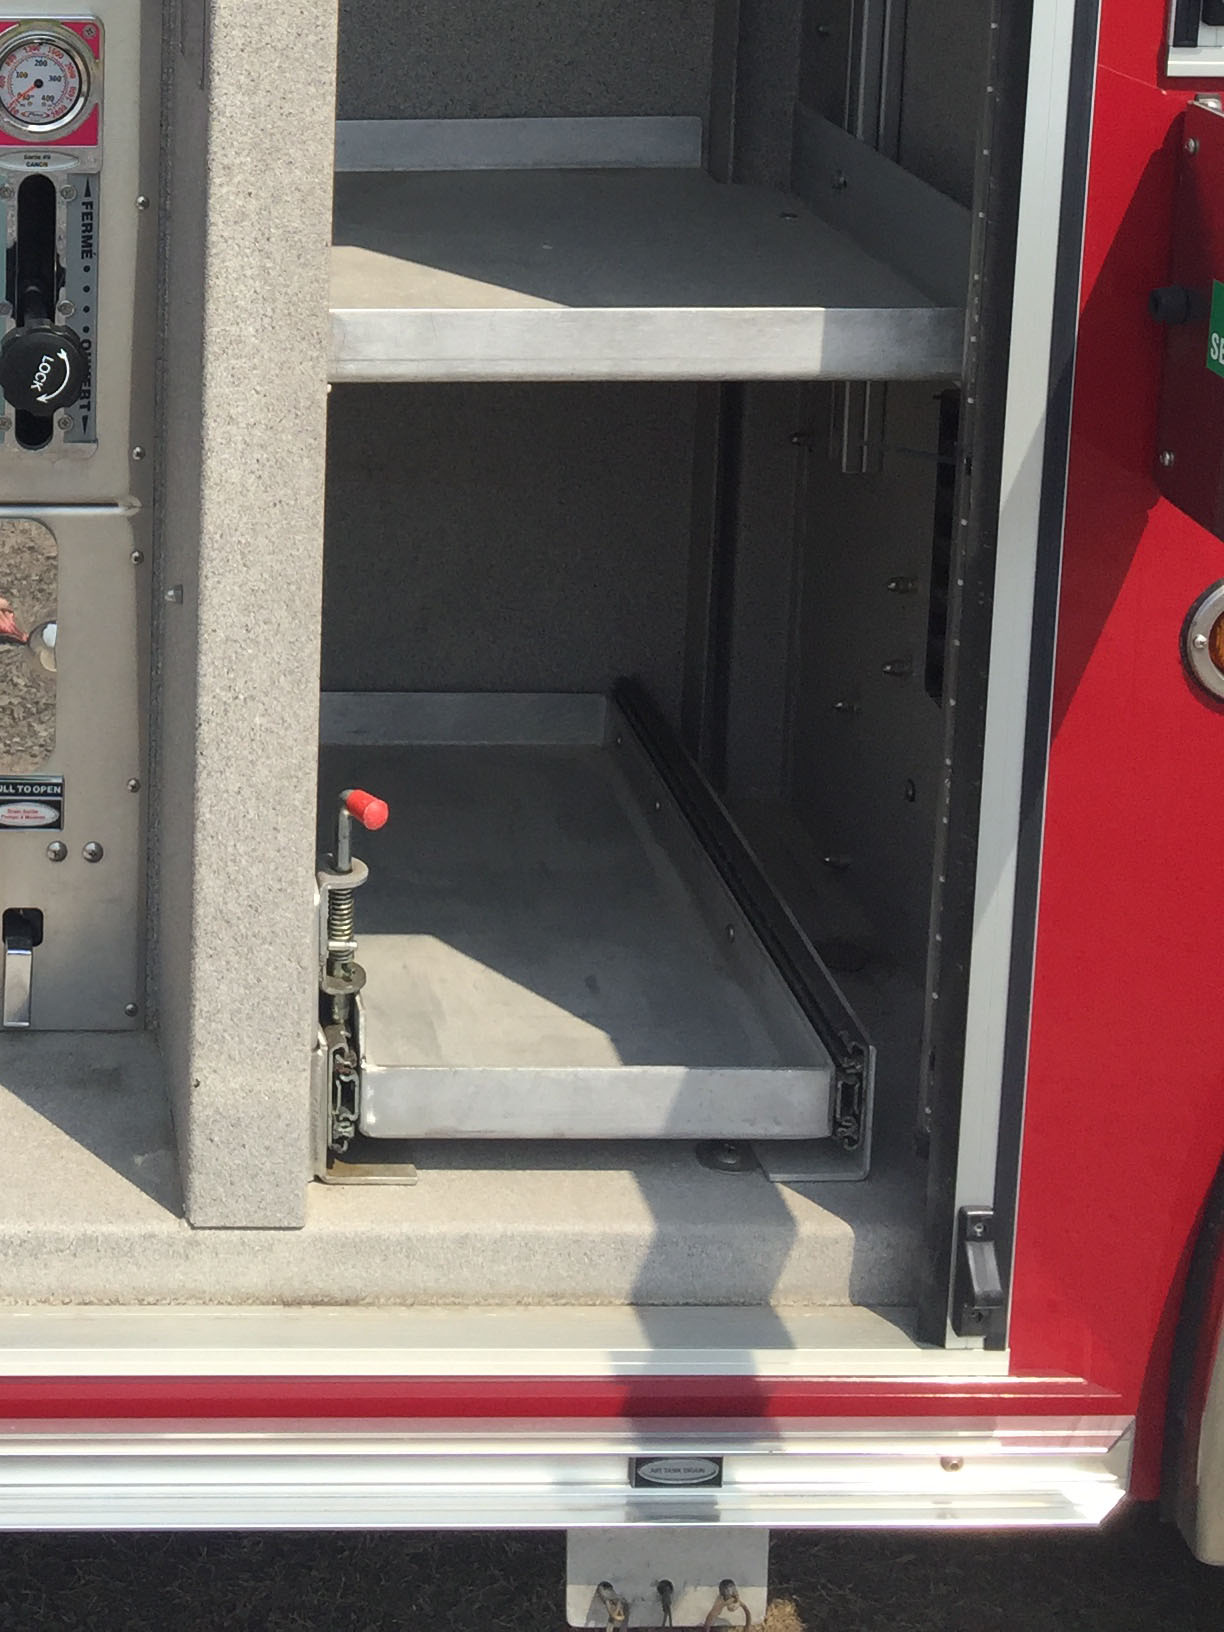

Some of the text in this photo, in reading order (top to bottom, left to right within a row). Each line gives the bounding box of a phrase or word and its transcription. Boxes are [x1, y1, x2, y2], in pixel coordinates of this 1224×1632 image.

[81, 201, 97, 260] FERMÉ
[30, 356, 54, 391] LOCK
[80, 339, 92, 411] OERT
[17, 786, 31, 794] TO
[33, 786, 61, 794] OPEN
